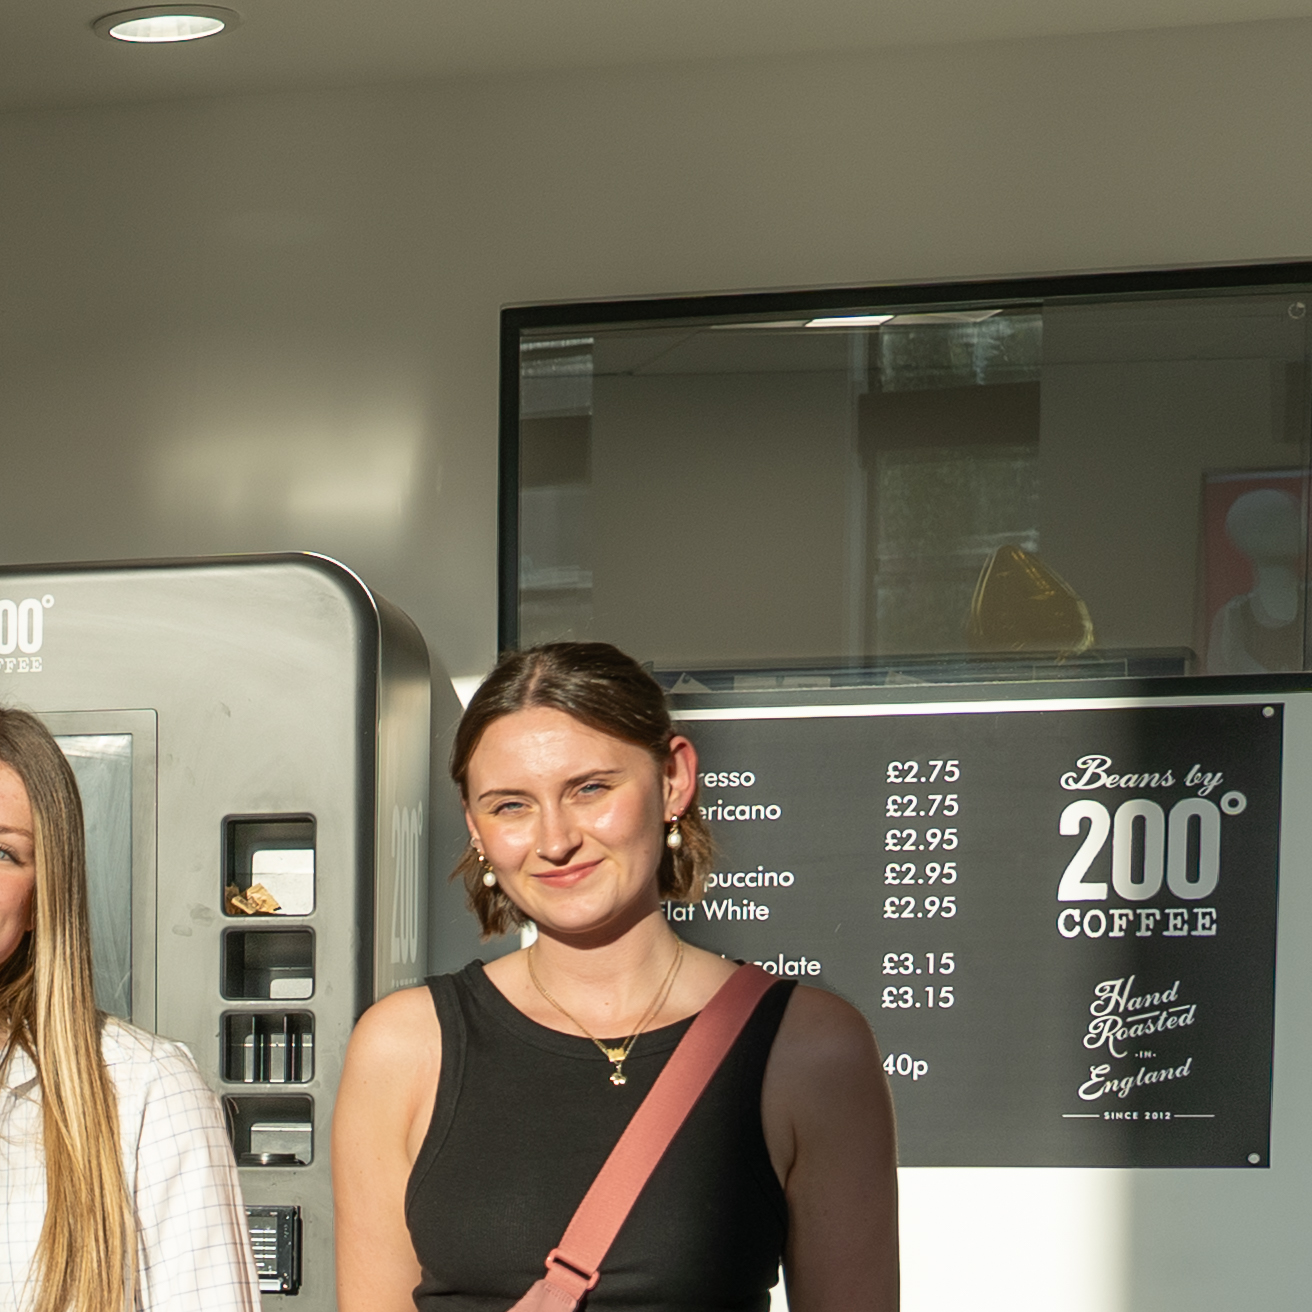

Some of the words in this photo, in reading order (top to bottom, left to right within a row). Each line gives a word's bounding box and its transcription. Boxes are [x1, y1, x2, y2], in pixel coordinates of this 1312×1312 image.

[697, 771, 756, 788] resso
[886, 760, 961, 784] £2.75
[1059, 754, 1177, 790] Beans
[1183, 764, 1224, 796] by
[699, 799, 782, 821] ericano
[885, 794, 960, 818] £2.75
[884, 828, 959, 852] £2.95
[703, 865, 795, 892] puccino
[883, 862, 958, 886] £2.95
[701, 898, 770, 921] White
[883, 896, 957, 920] £2.95
[1057, 907, 1218, 939] COFFEE
[882, 953, 956, 977] £3.15
[881, 986, 955, 1010] £3.15
[1089, 974, 1181, 1017] Hand
[1082, 1004, 1197, 1059] Roasted
[882, 1053, 929, 1081] 40p
[1077, 1057, 1193, 1101] England
[1103, 1111, 1139, 1120] SINCE
[1144, 1111, 1172, 1120] 2012
